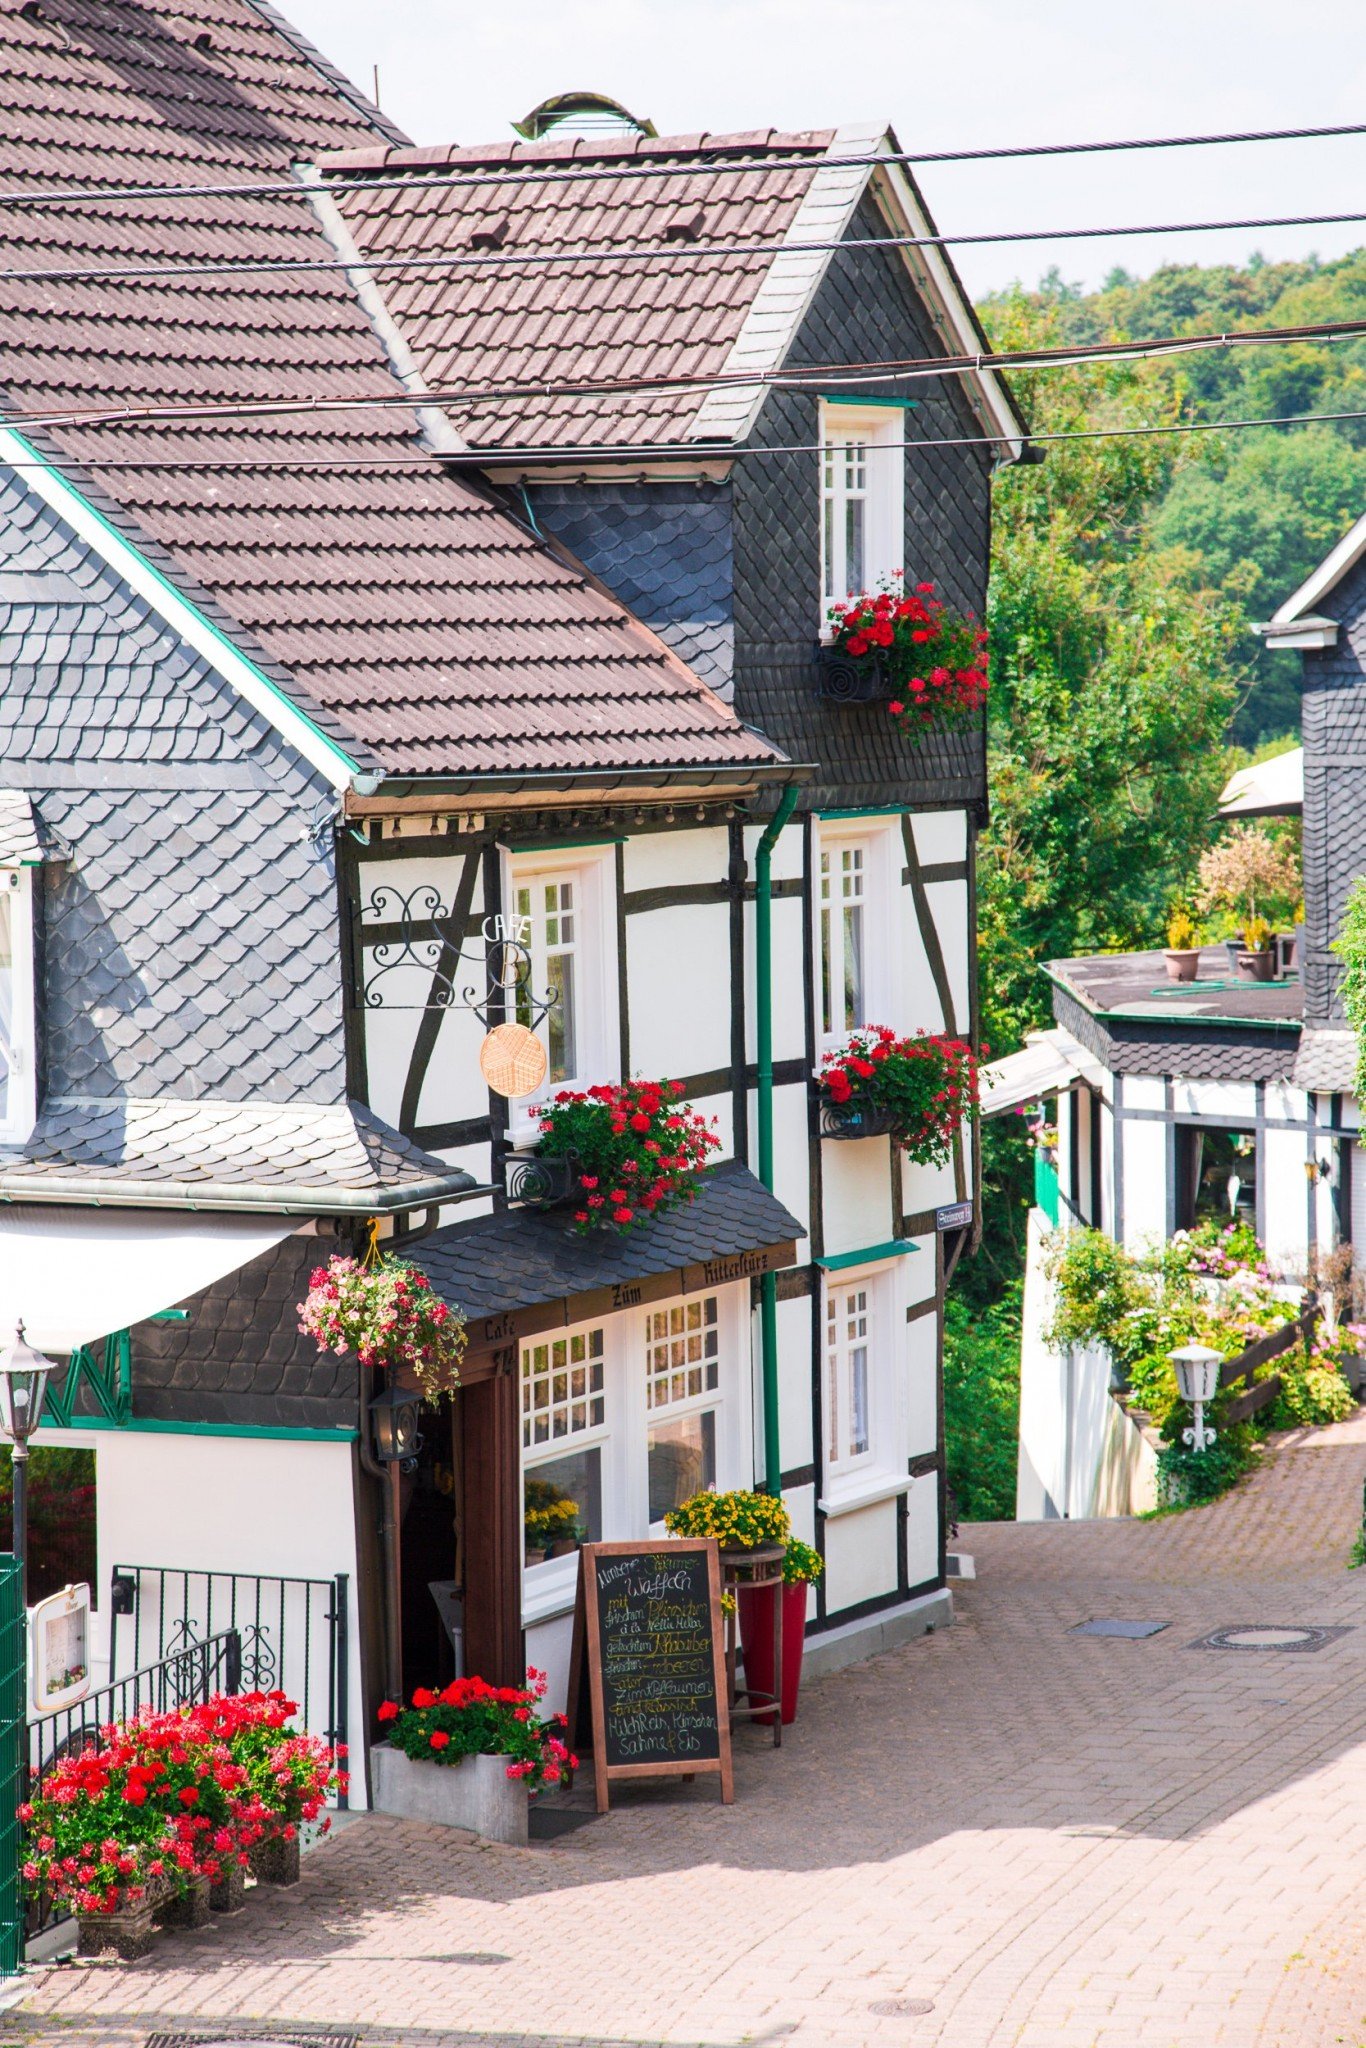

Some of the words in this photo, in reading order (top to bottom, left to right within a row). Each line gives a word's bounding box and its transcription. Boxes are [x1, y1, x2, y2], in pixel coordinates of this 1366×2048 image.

[481, 913, 535, 943] CAFE
[501, 944, 520, 987] B
[624, 1570, 692, 1600] Waffeln
[608, 1594, 628, 1610] mit
[678, 1729, 700, 1751] Eis
